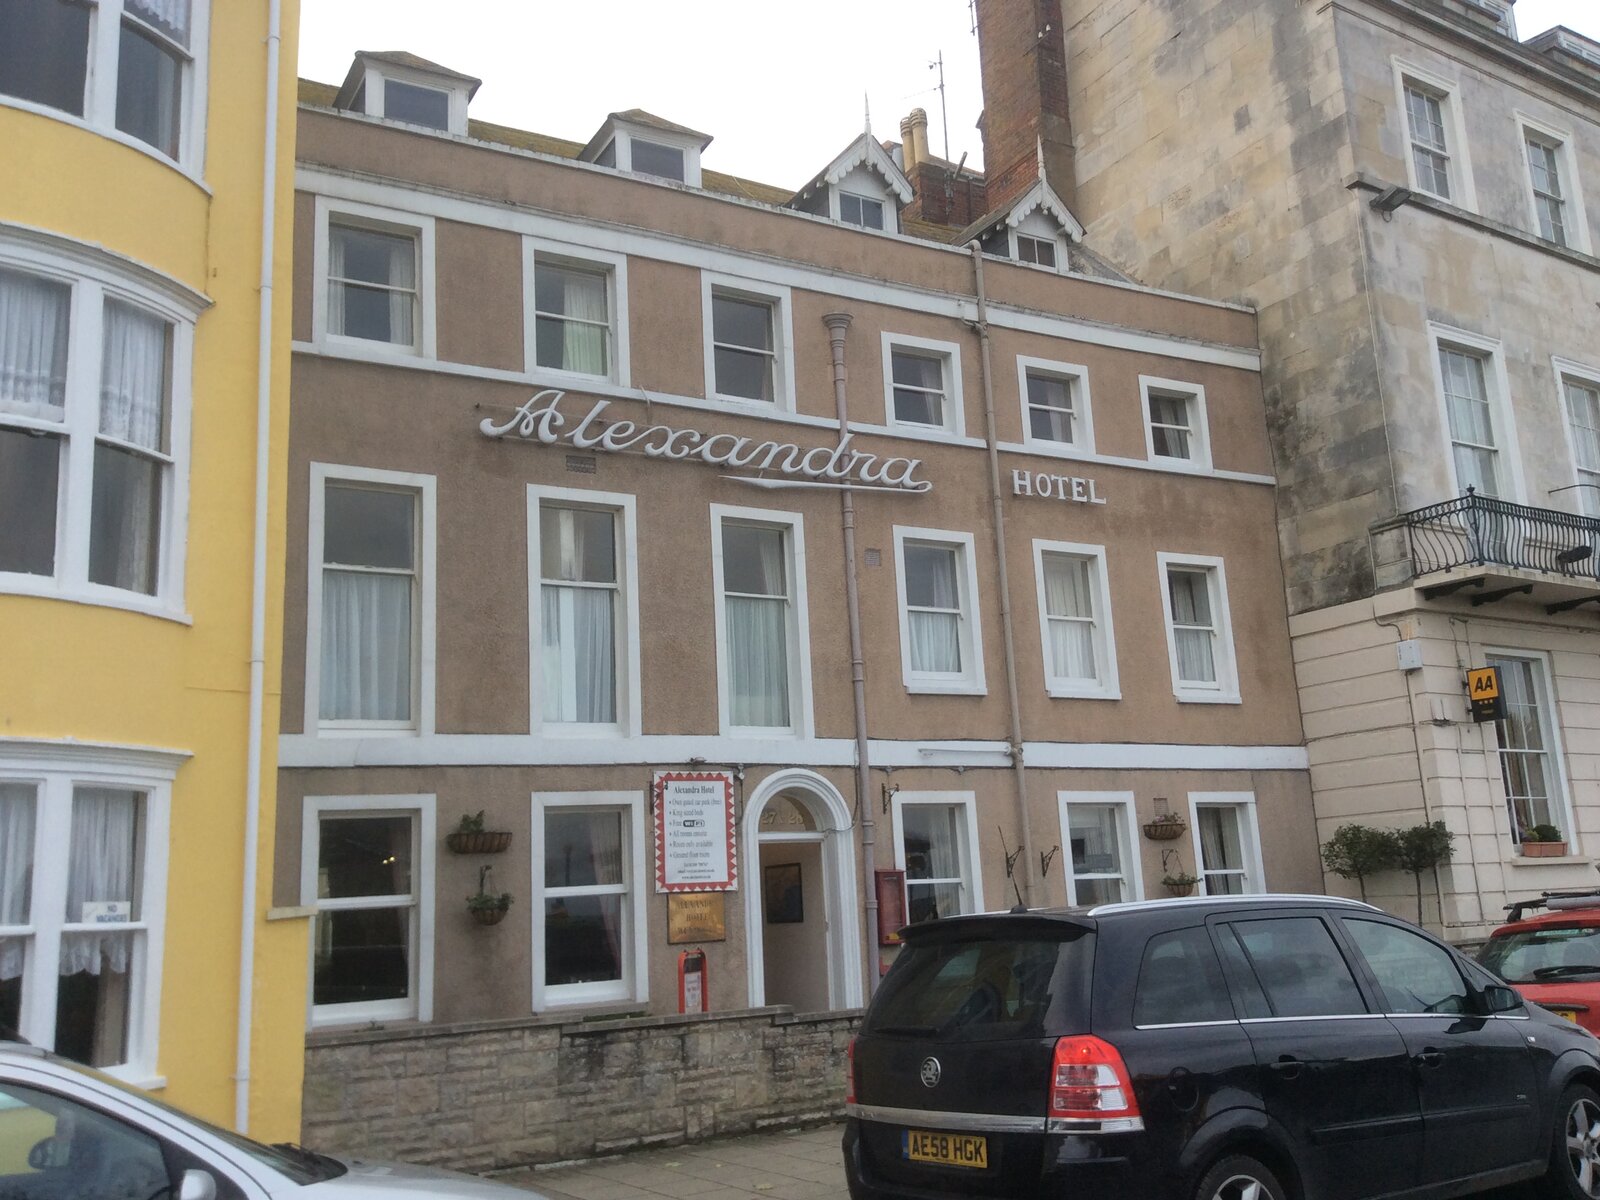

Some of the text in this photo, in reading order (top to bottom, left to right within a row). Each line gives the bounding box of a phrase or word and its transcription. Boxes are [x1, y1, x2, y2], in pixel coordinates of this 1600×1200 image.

[479, 390, 932, 491] Alexandra
[1012, 469, 1107, 504] HOTEL
[1474, 675, 1493, 693] AA
[701, 785, 714, 794] Hotel
[672, 810, 682, 818] King
[912, 1134, 984, 1162] AE58 HGK
